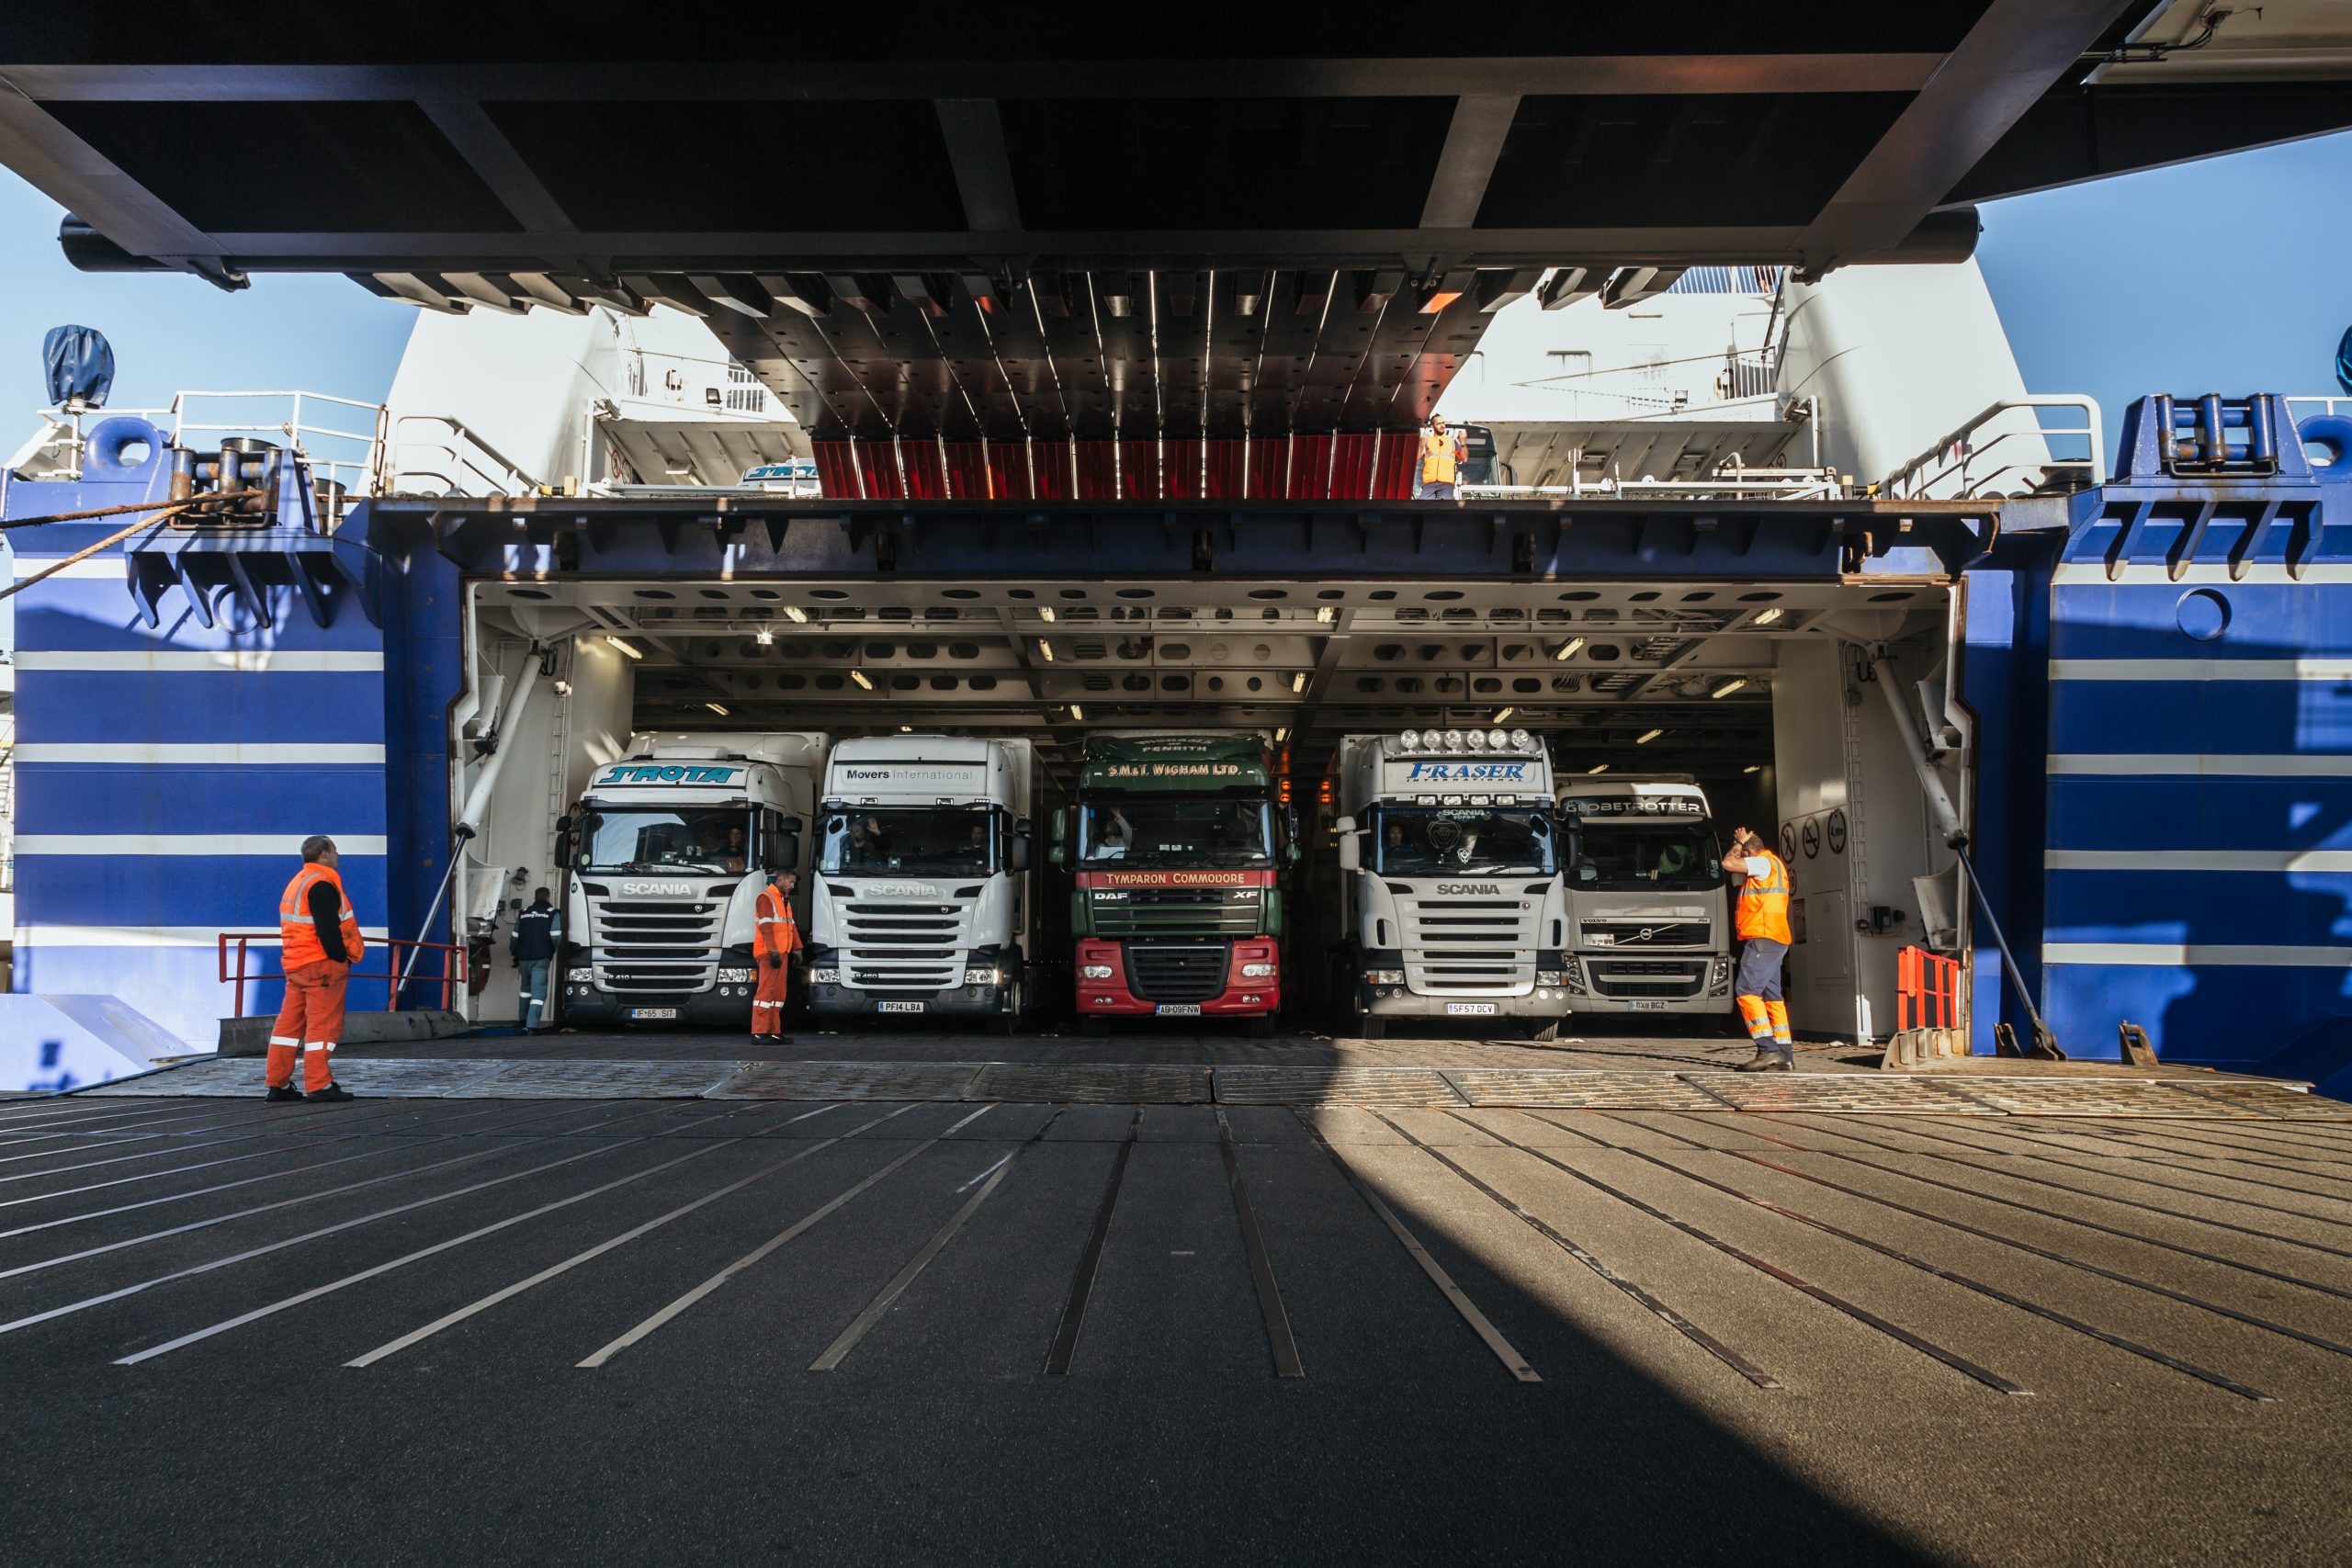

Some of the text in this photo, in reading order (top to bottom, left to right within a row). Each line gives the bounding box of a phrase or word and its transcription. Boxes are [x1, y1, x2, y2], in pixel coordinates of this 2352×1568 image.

[598, 765, 744, 784] TROTA
[846, 770, 973, 780] Movers International
[1153, 764, 1209, 776] WIGHAM
[1407, 761, 1527, 779] FRASER
[1566, 802, 1700, 813] GLOBETROTTER
[1106, 873, 1245, 885] TYMPARON COMMODORE
[623, 883, 692, 896] SCANIA
[869, 885, 938, 897] SCANIA
[1436, 884, 1500, 896] SCANIA
[1094, 892, 1128, 900] DAF
